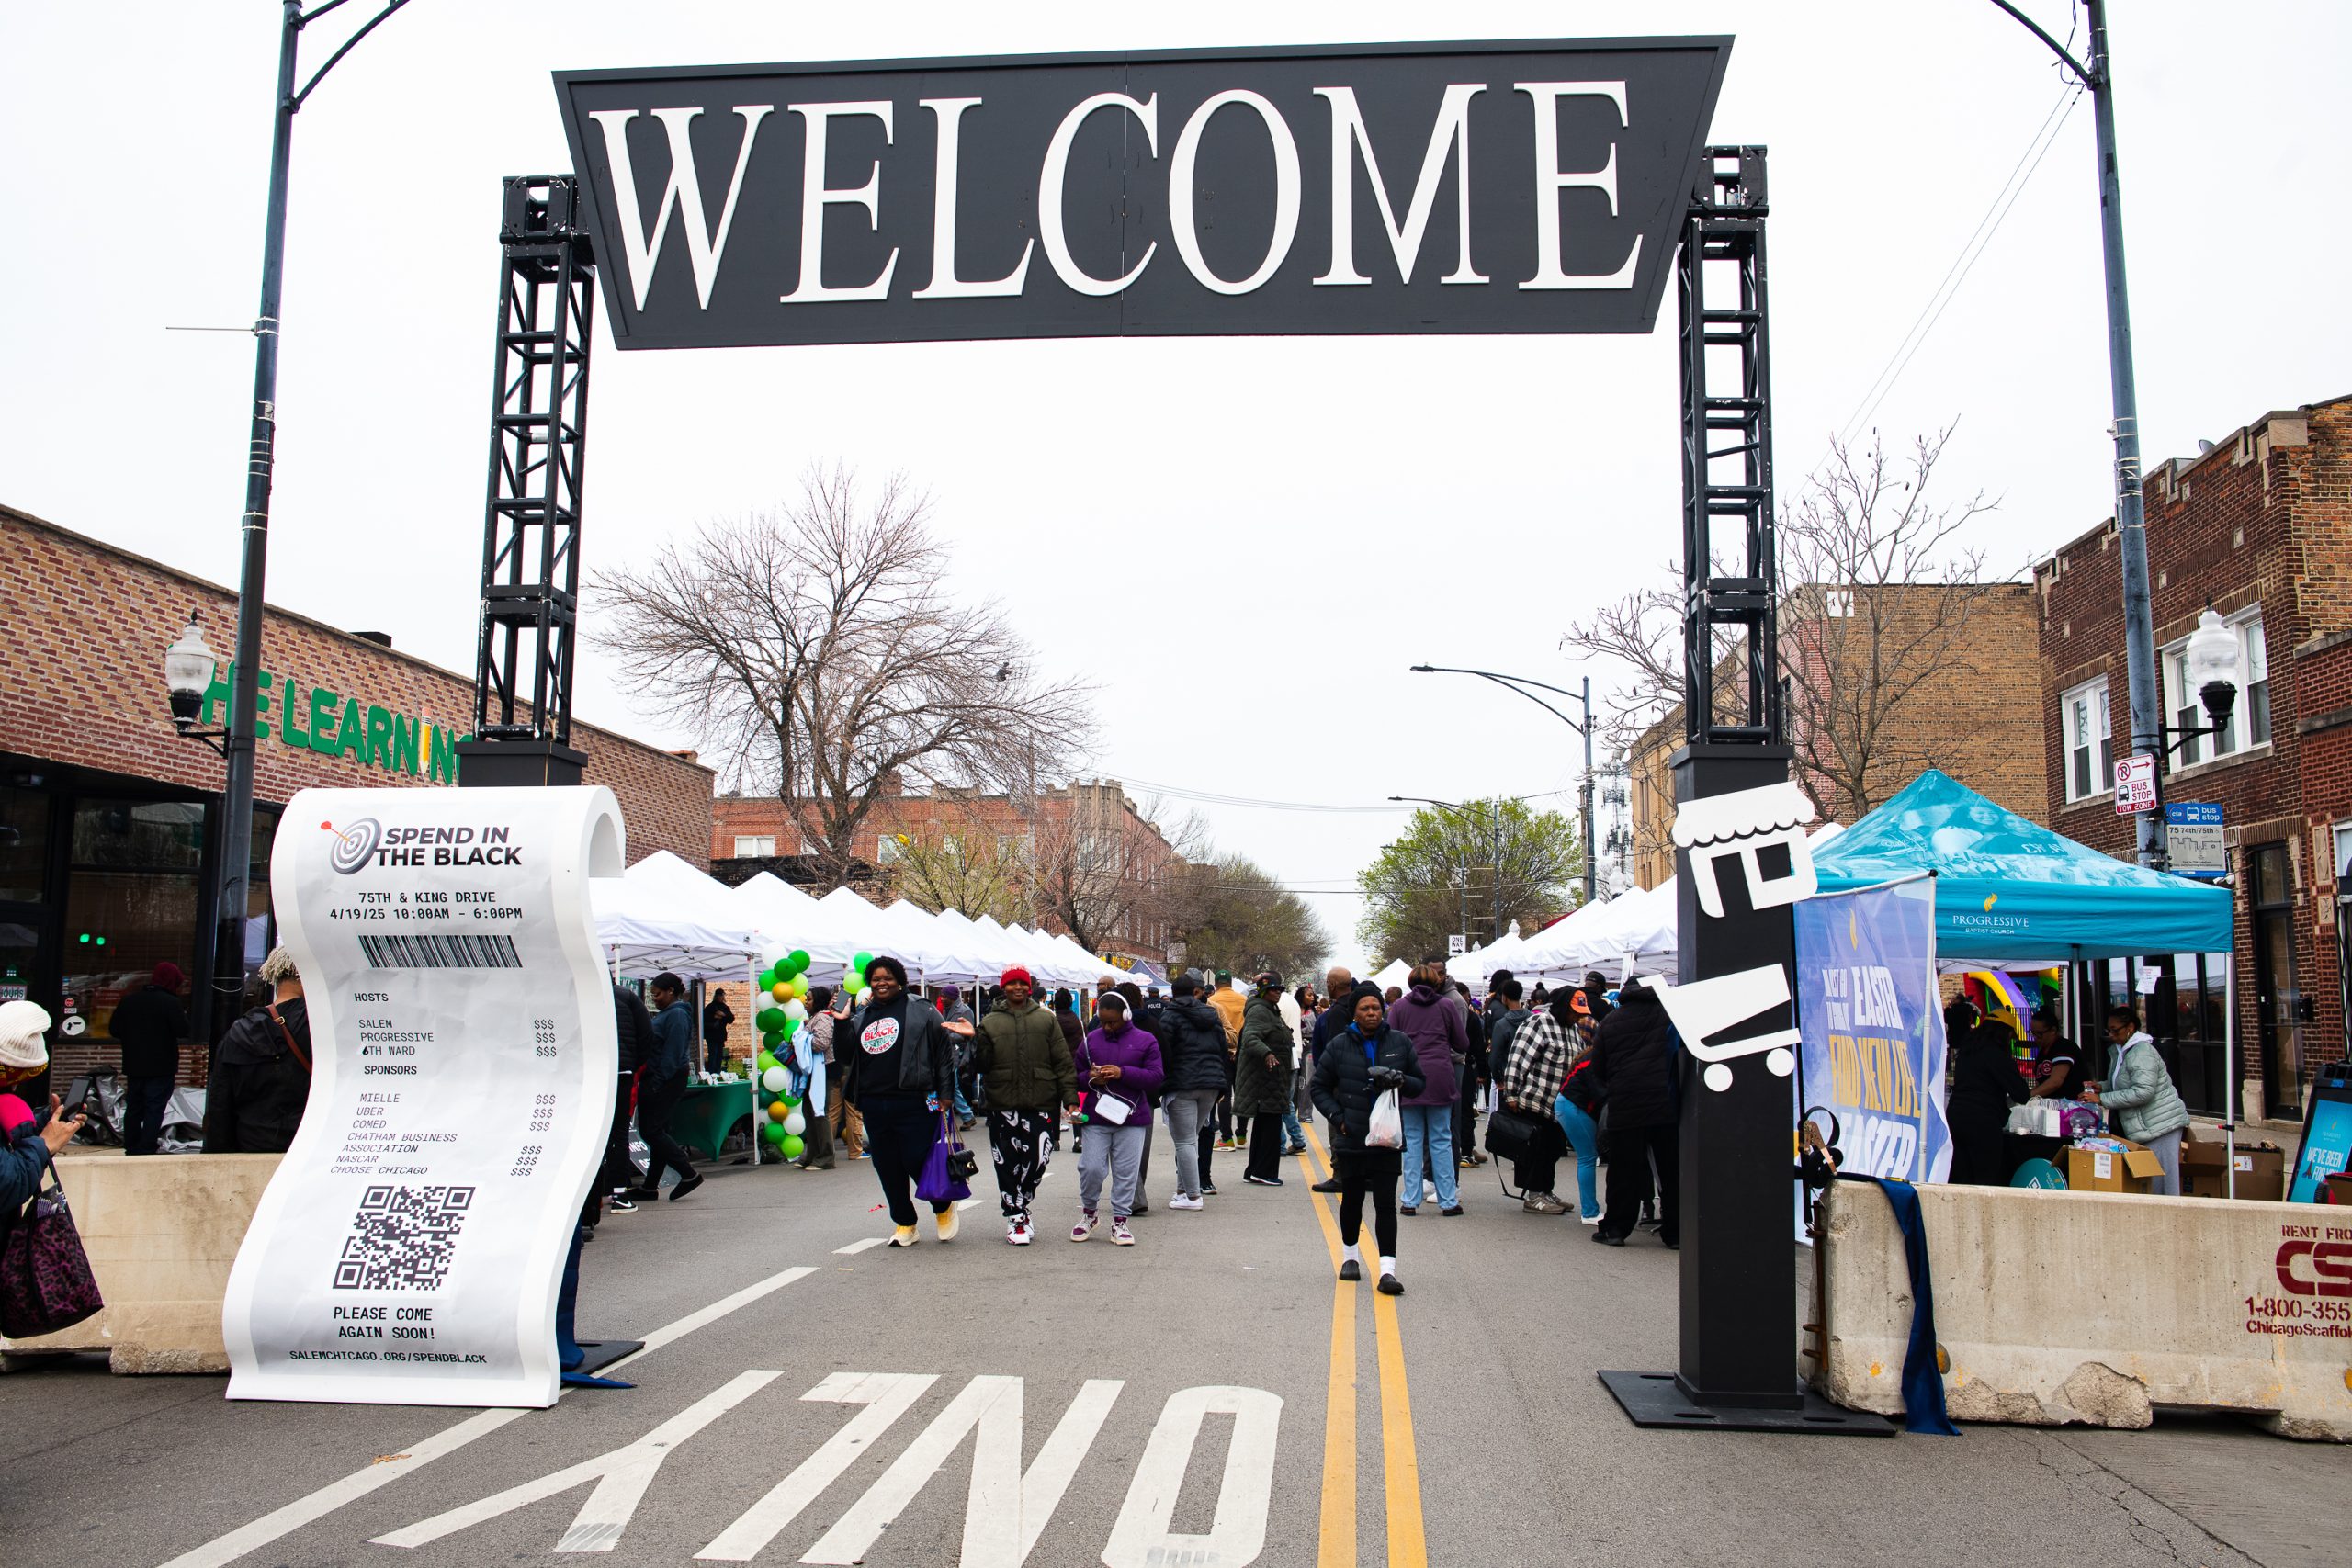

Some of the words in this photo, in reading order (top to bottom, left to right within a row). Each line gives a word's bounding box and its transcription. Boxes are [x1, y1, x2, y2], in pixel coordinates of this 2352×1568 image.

[588, 80, 1645, 314] WELCOME
[2132, 782, 2148, 792] BUS
[2132, 790, 2153, 801] STOP
[2119, 804, 2132, 813] TOW
[2134, 801, 2153, 810] ZONE
[2201, 814, 2221, 822] stop
[385, 827, 475, 845] SPEND
[481, 826, 510, 844] IN
[375, 847, 425, 867] THE
[434, 846, 523, 866] BLACK
[358, 891, 391, 904] 75TH
[399, 893, 408, 903] &
[414, 892, 448, 903] KING
[455, 891, 496, 903] DRIVE
[329, 908, 386, 919] 4/19/25
[393, 908, 450, 919] 10:00AM
[473, 908, 523, 919] 6:00PM
[1952, 915, 2030, 928] PROGRESSIVE
[354, 993, 389, 1002] HOSTS
[1851, 965, 1904, 1030] EASTR
[358, 1019, 392, 1029] SALEM
[534, 1019, 554, 1031] $$$
[360, 1032, 435, 1043] PROGRESSIVE
[536, 1032, 556, 1043] $$$
[865, 1026, 894, 1041] BLACK
[362, 1045, 382, 1055] 6TH
[389, 1045, 415, 1055] WARD
[537, 1046, 557, 1057] $$$
[364, 1065, 417, 1075] SPONSORS
[1857, 1037, 1892, 1113] NEW
[359, 1093, 401, 1103] MIELLE
[536, 1094, 556, 1105] $$$
[356, 1107, 384, 1116] UBER
[533, 1108, 553, 1119] $$$
[352, 1120, 387, 1130] COMED
[529, 1122, 550, 1132] $$$
[347, 1132, 396, 1142] CHATHAM
[401, 1133, 458, 1143] BUSINESS
[342, 1144, 419, 1153] ASSOCIATION
[521, 1145, 542, 1155] $$$
[335, 1155, 379, 1164] NASCAR
[515, 1156, 538, 1166] $$$
[2324, 1149, 2344, 1168] BEEN
[330, 1166, 373, 1175] CHOOSE
[378, 1166, 428, 1175] CHICAGO
[510, 1167, 532, 1177] $$$
[2281, 1224, 2319, 1238] RENT
[334, 1306, 388, 1321] PLEASE
[396, 1307, 433, 1321] COME
[338, 1326, 383, 1338] AGAIN
[391, 1327, 435, 1339] SOON!
[289, 1350, 487, 1364] SALEMCHICAGO.ORG/SPENDBLACK
[367, 1369, 1285, 1568] ONLY
